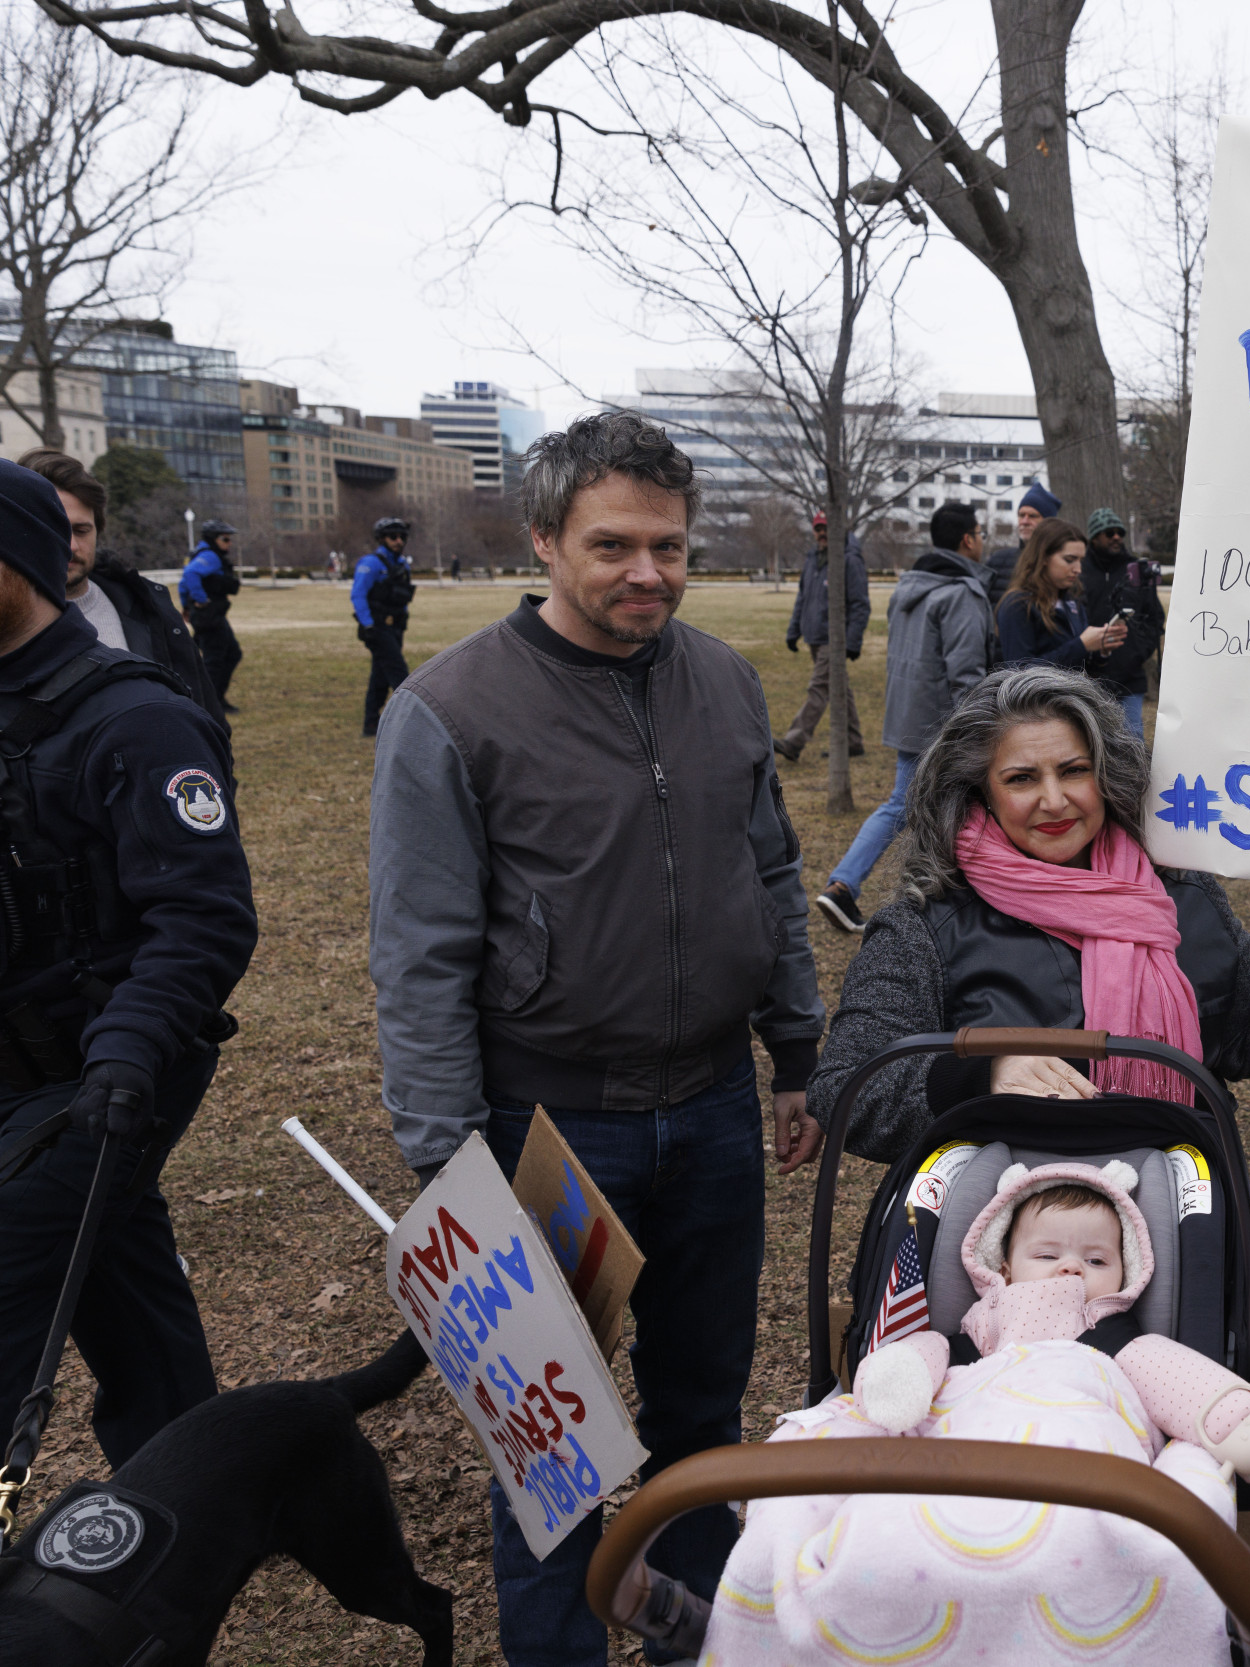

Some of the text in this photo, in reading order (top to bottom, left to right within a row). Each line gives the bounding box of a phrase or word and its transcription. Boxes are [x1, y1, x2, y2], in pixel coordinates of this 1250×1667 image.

[397, 1205, 480, 1340] VALUE
[432, 1233, 535, 1402] AMERICAN
[472, 1352, 525, 1425] IS AN
[489, 1358, 587, 1488] SERVICE
[57, 1516, 77, 1534] K-9
[524, 1432, 602, 1534] PUBLIC
